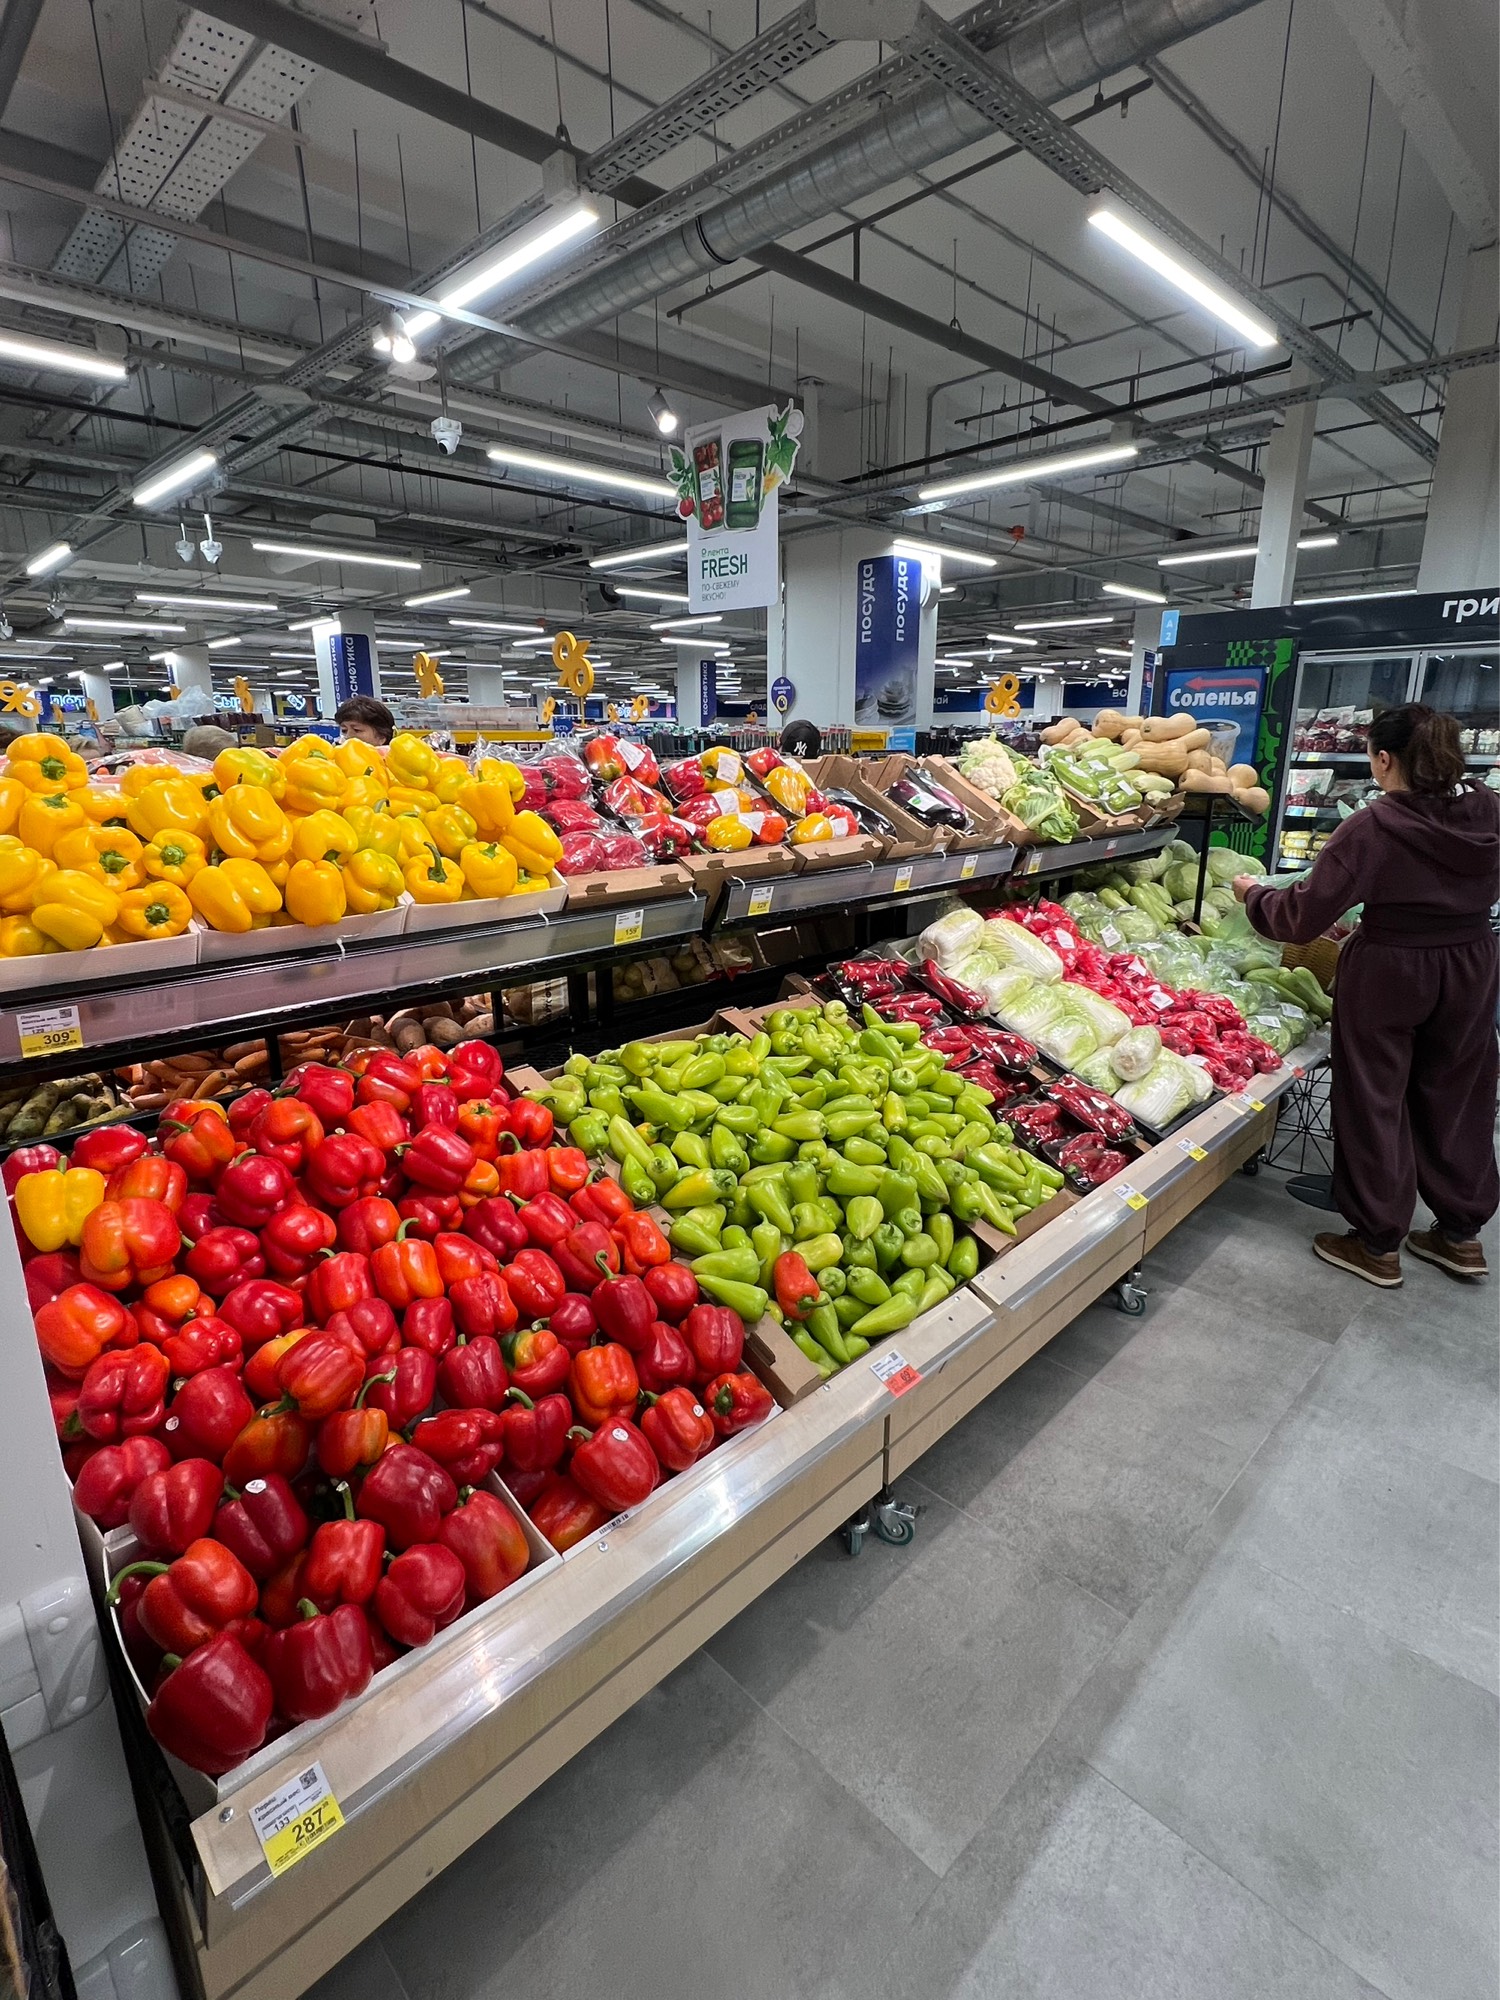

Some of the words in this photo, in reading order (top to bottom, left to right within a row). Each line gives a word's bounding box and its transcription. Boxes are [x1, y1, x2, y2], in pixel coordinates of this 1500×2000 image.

[701, 553, 748, 580] FRESH
[861, 563, 876, 643] посуда
[896, 560, 909, 642] посуда
[1442, 597, 1500, 623] гри
[1165, 632, 1172, 641] 2
[345, 636, 360, 699] осметика
[1169, 688, 1258, 707] Соленья
[43, 1031, 70, 1044] 309
[254, 1796, 277, 1815] Перец
[274, 1816, 291, 1832] 133
[292, 1807, 323, 1843] 287
